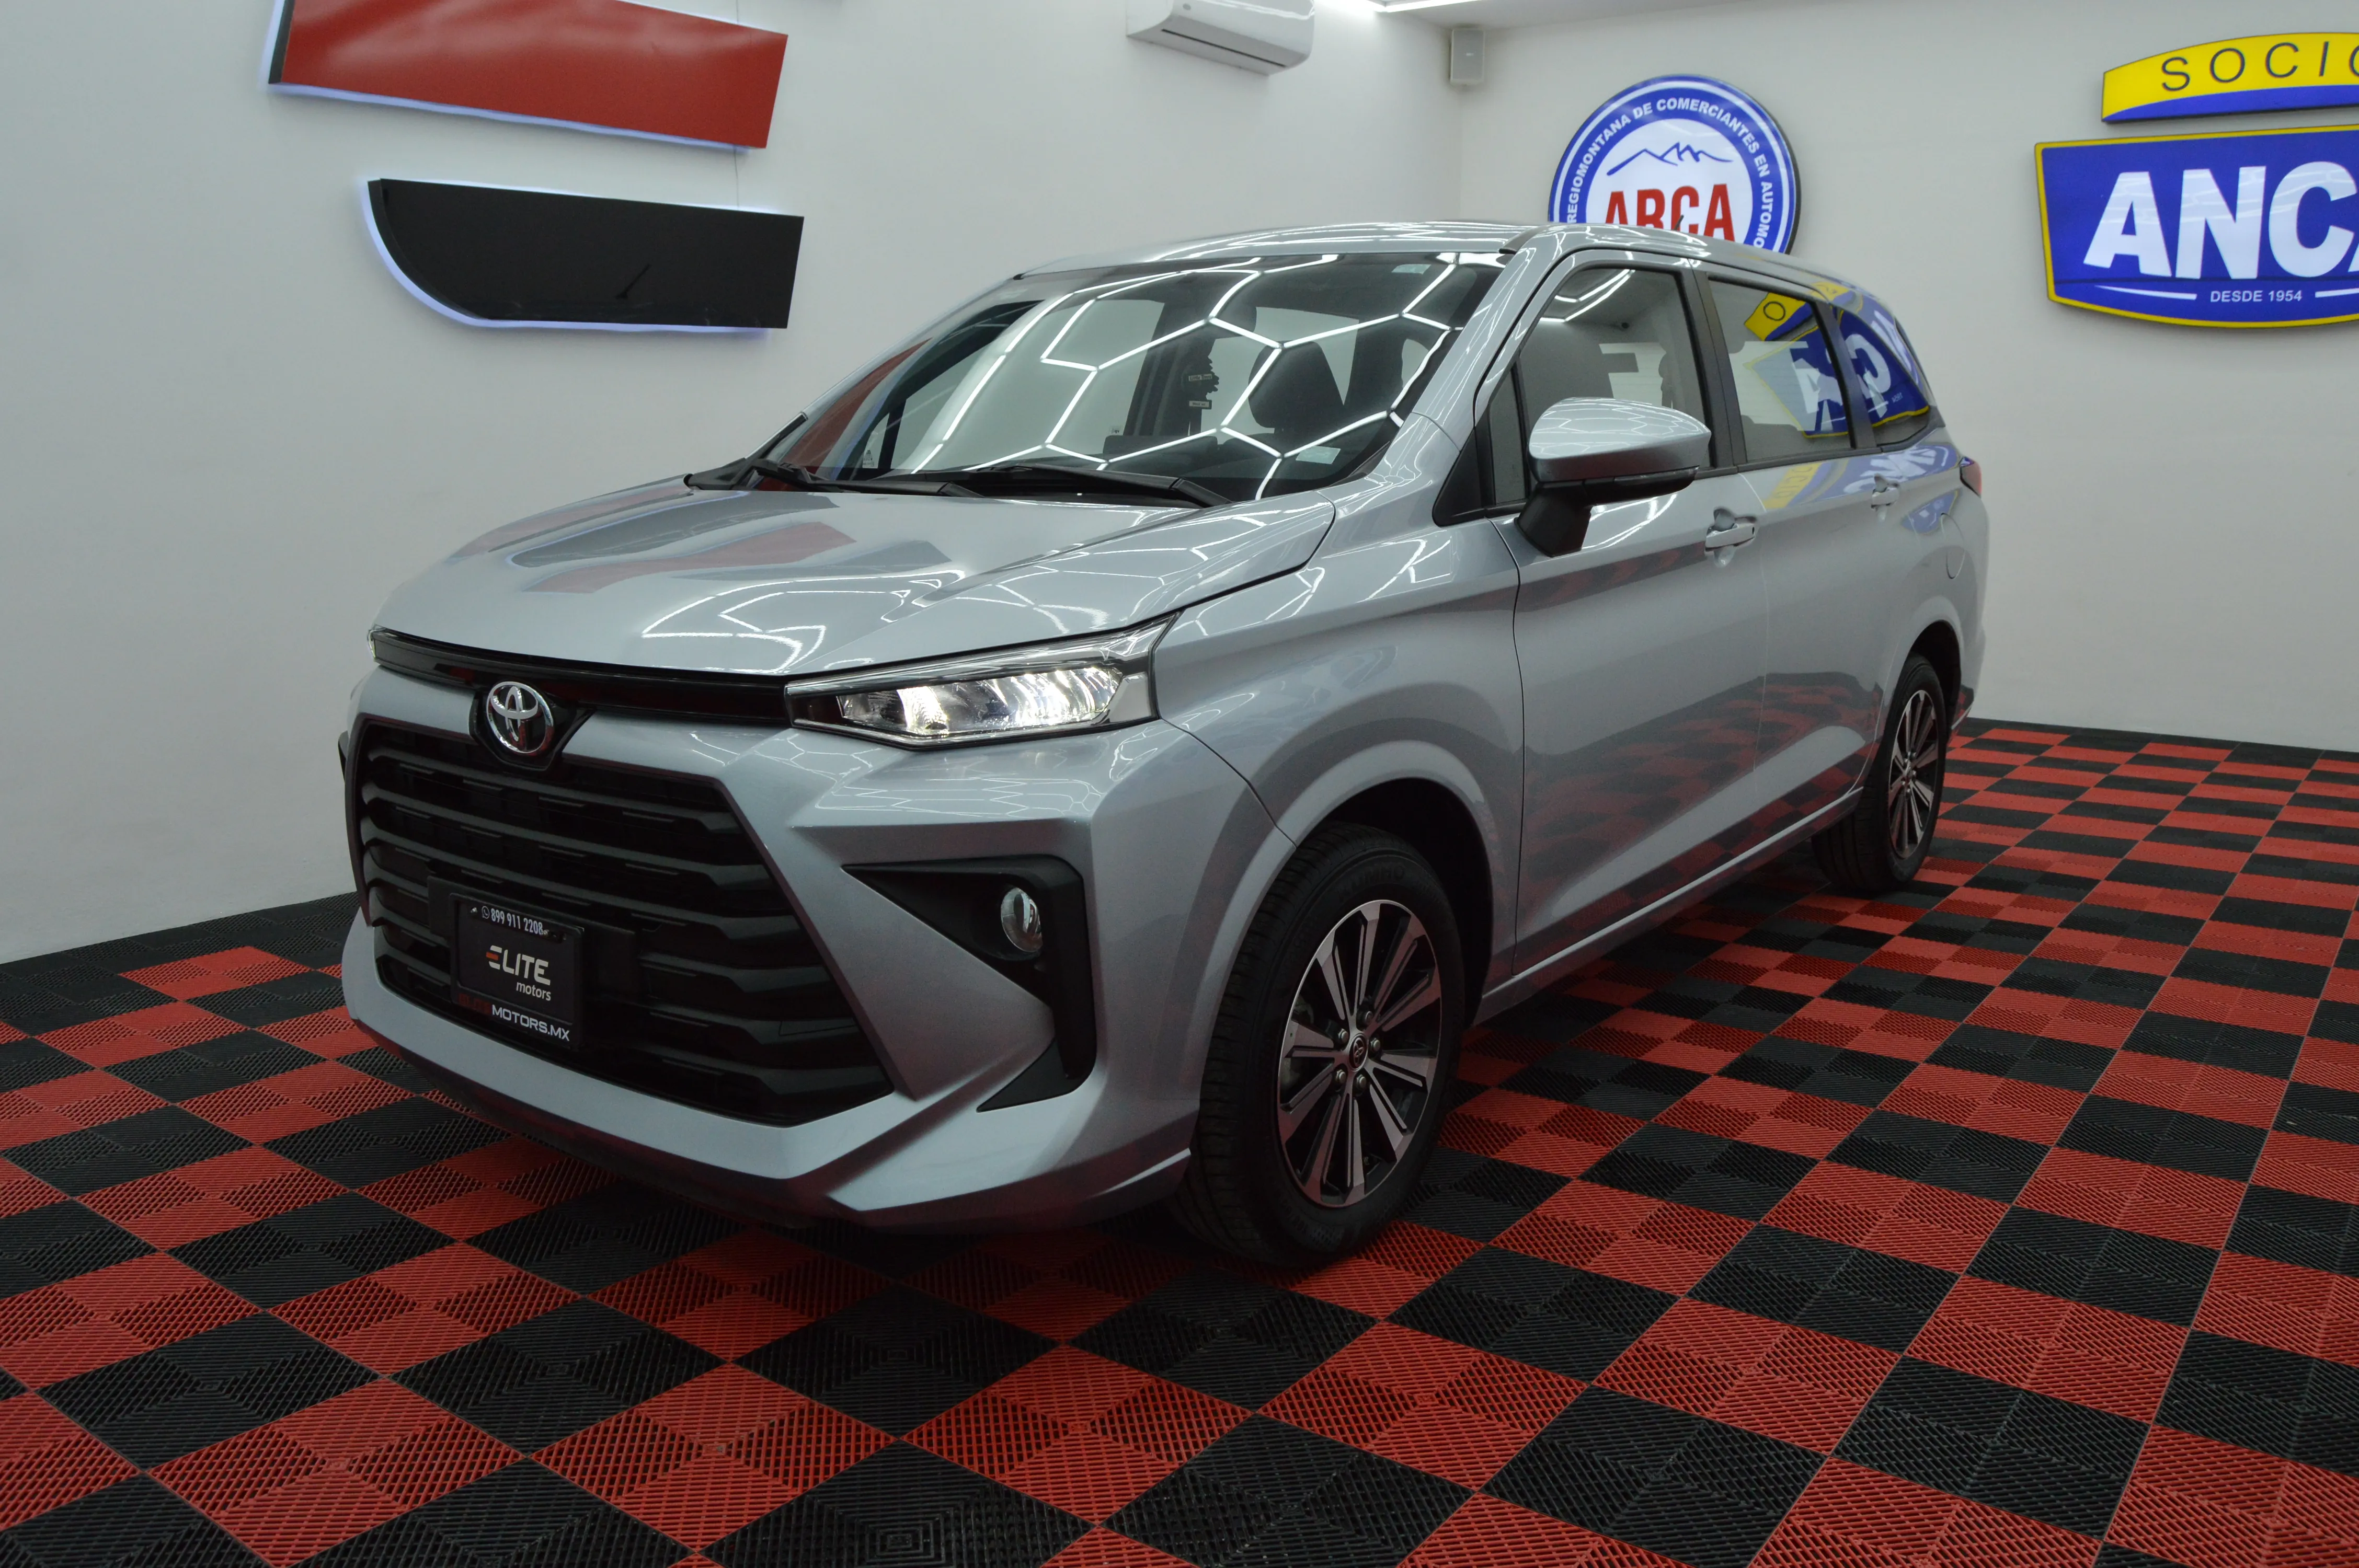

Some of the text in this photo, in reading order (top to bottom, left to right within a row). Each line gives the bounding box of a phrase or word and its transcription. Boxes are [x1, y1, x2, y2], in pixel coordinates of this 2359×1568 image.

[1567, 114, 1631, 223] REGIOMONTANA
[1633, 102, 1653, 120] DE
[1656, 98, 1760, 154] COMERCIANTES
[1754, 154, 1770, 178] EN
[2083, 161, 2359, 279] ANC
[2211, 290, 2302, 302] DESDE 1954
[491, 908, 543, 935] 899 911 2208
[486, 945, 551, 985] ELITE
[516, 982, 551, 1001] motors
